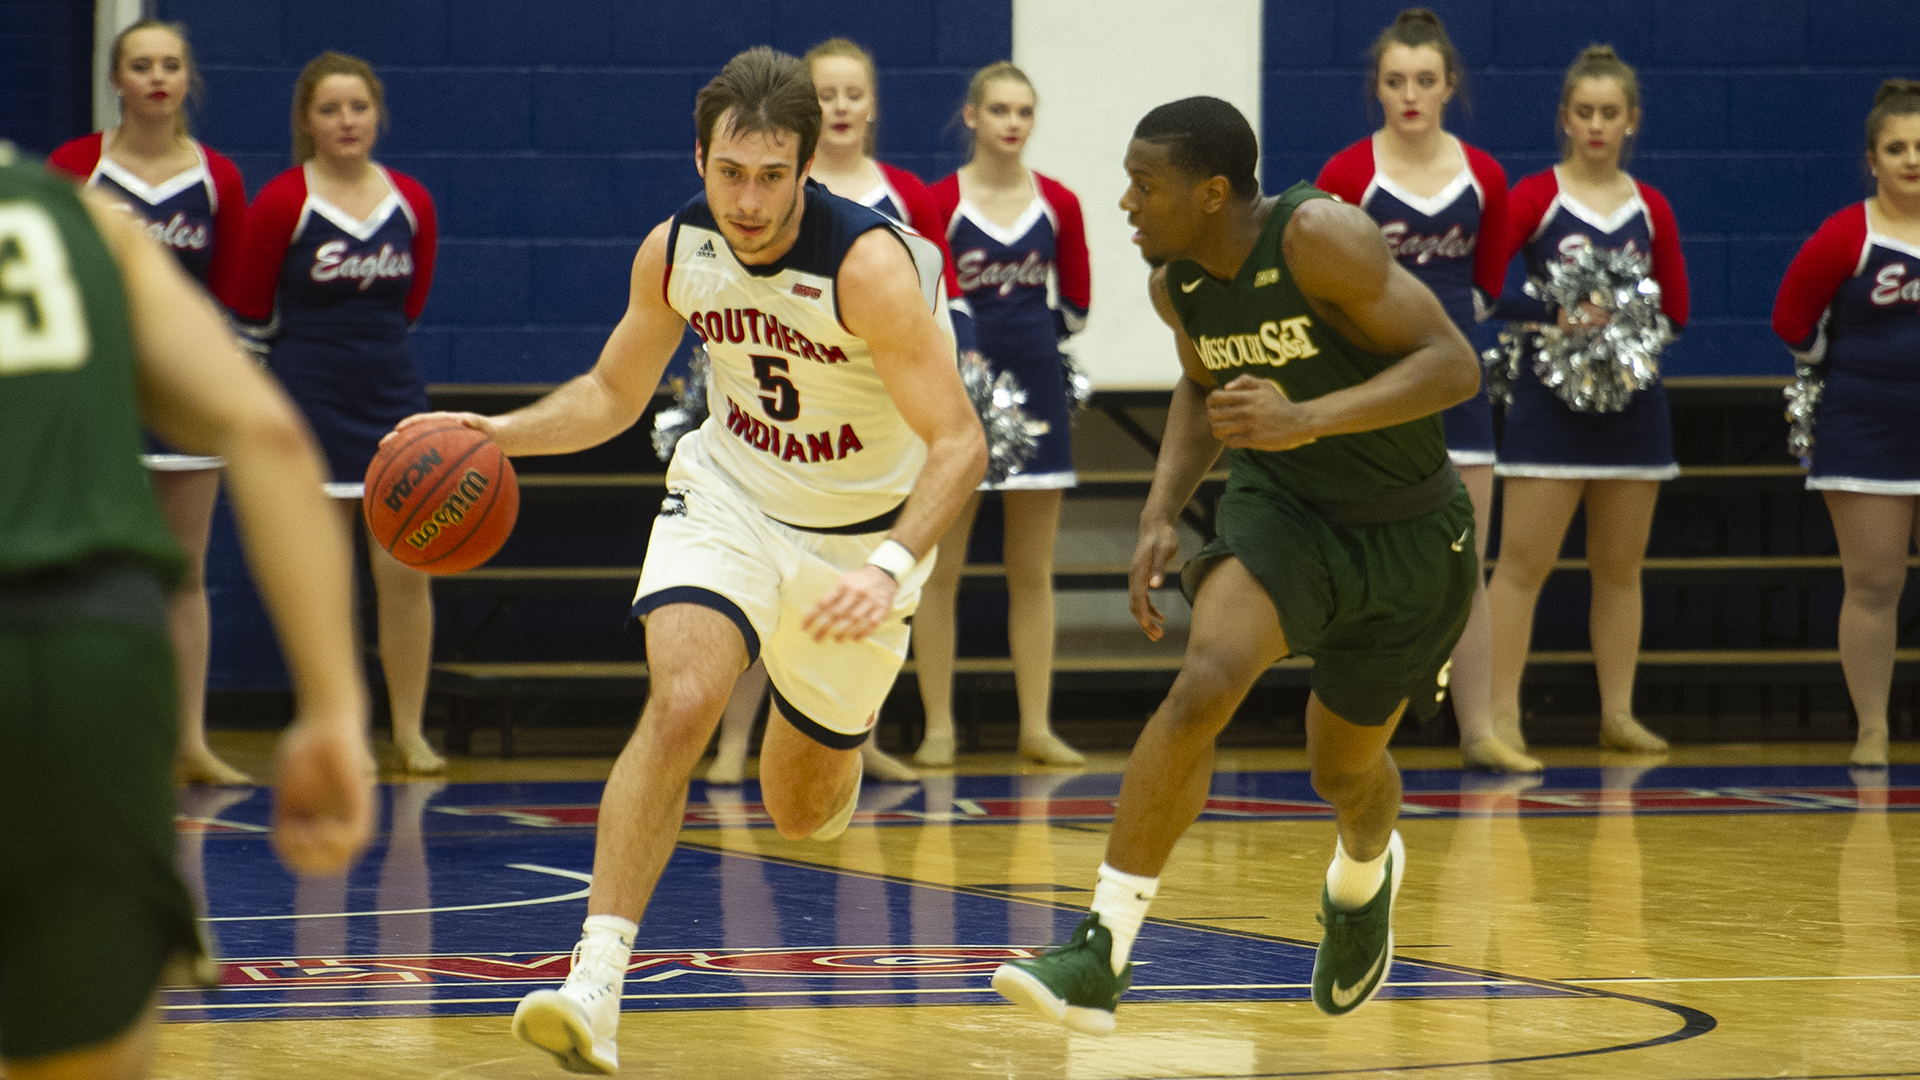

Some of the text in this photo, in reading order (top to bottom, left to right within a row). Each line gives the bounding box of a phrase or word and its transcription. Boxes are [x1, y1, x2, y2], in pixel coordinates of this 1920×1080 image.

[310, 240, 413, 291] Eagles
[689, 308, 850, 365] SOUTHERN
[1259, 314, 1320, 367] S&T
[747, 353, 800, 422] 5
[726, 396, 864, 463] INDIANA
[384, 448, 444, 513] NCAA
[405, 468, 490, 549] Wilson
